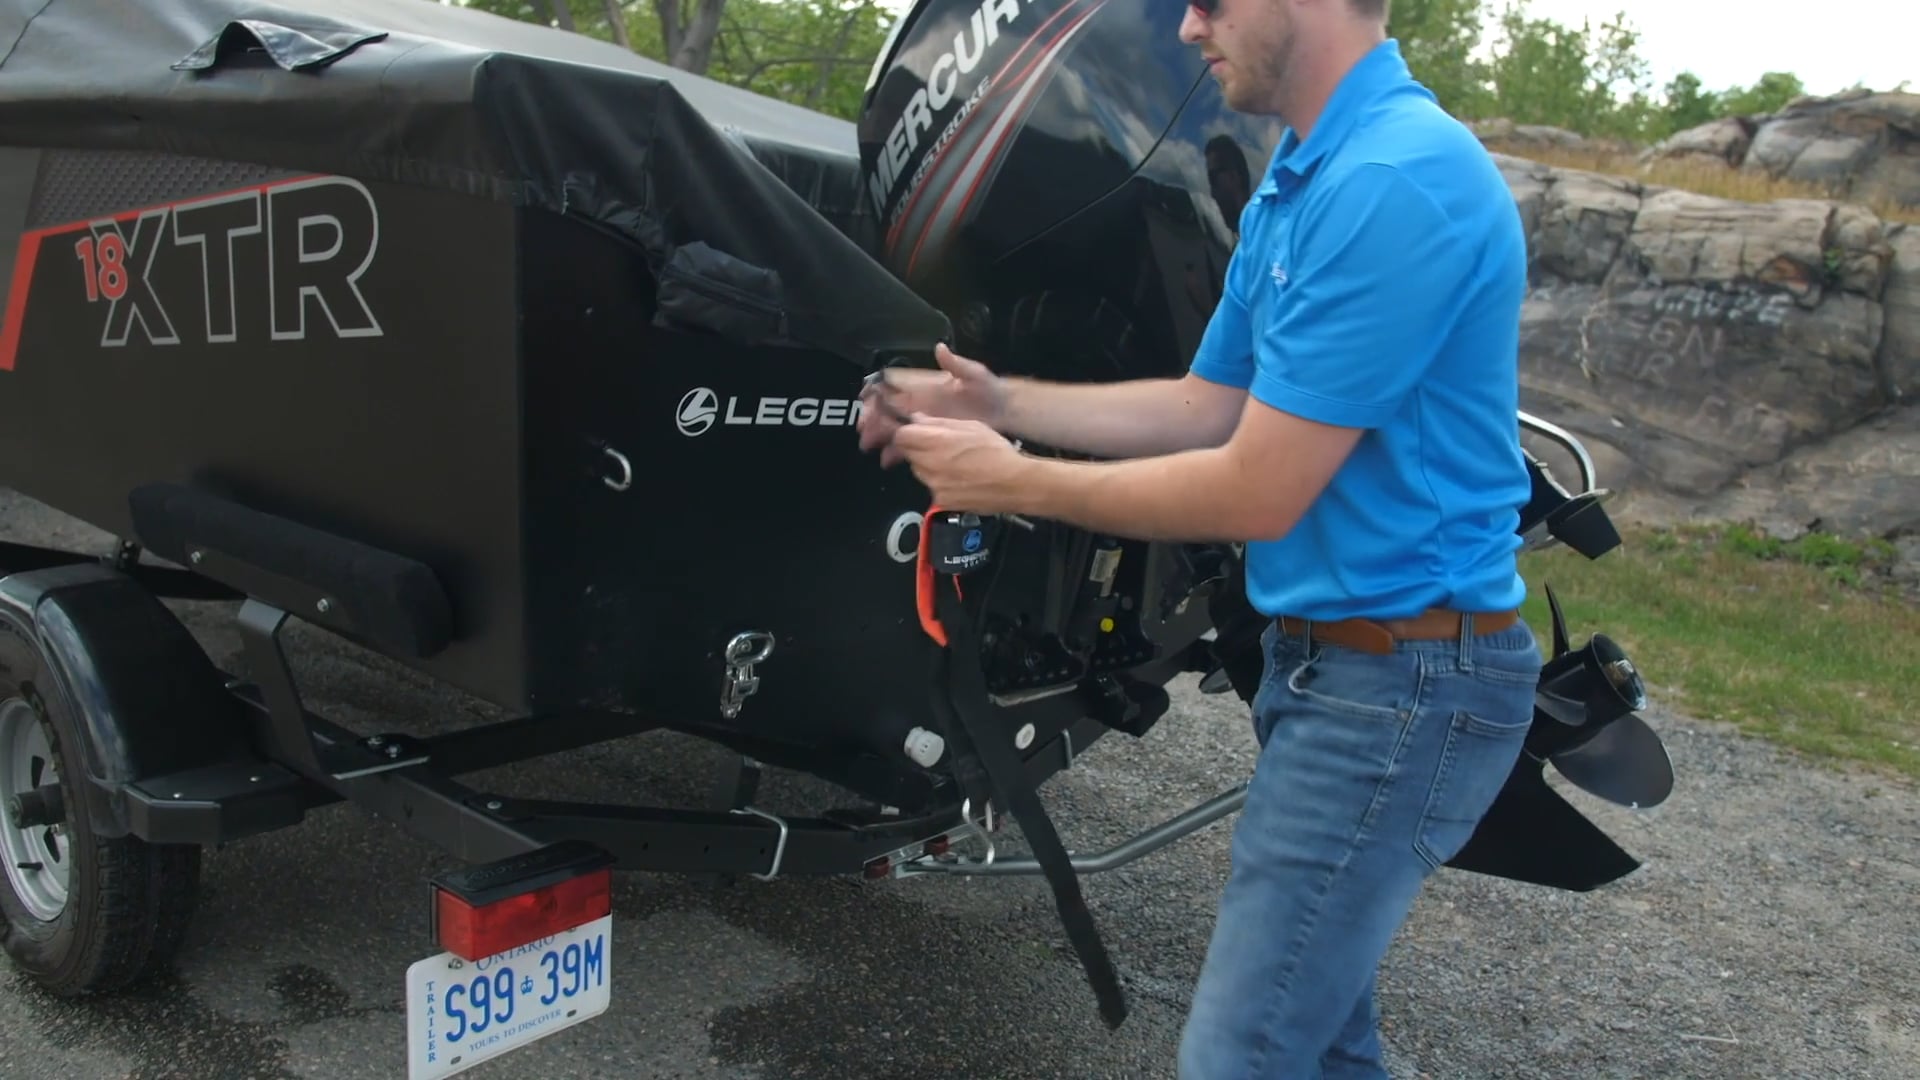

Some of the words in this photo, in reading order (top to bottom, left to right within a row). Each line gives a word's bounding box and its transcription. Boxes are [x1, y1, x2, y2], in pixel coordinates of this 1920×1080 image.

[869, 0, 1034, 224] MERCUR
[889, 75, 993, 228] FOURSTROKE
[75, 233, 128, 302] 18
[89, 175, 384, 346] XTR
[445, 967, 514, 1042] S99
[540, 934, 603, 1005] 39M
[475, 934, 555, 972] ONTARIO
[426, 981, 436, 1063] TRAILER
[469, 1035, 500, 1052] YOURS
[503, 1027, 516, 1039] TO
[517, 1008, 562, 1033] DISCOVER
